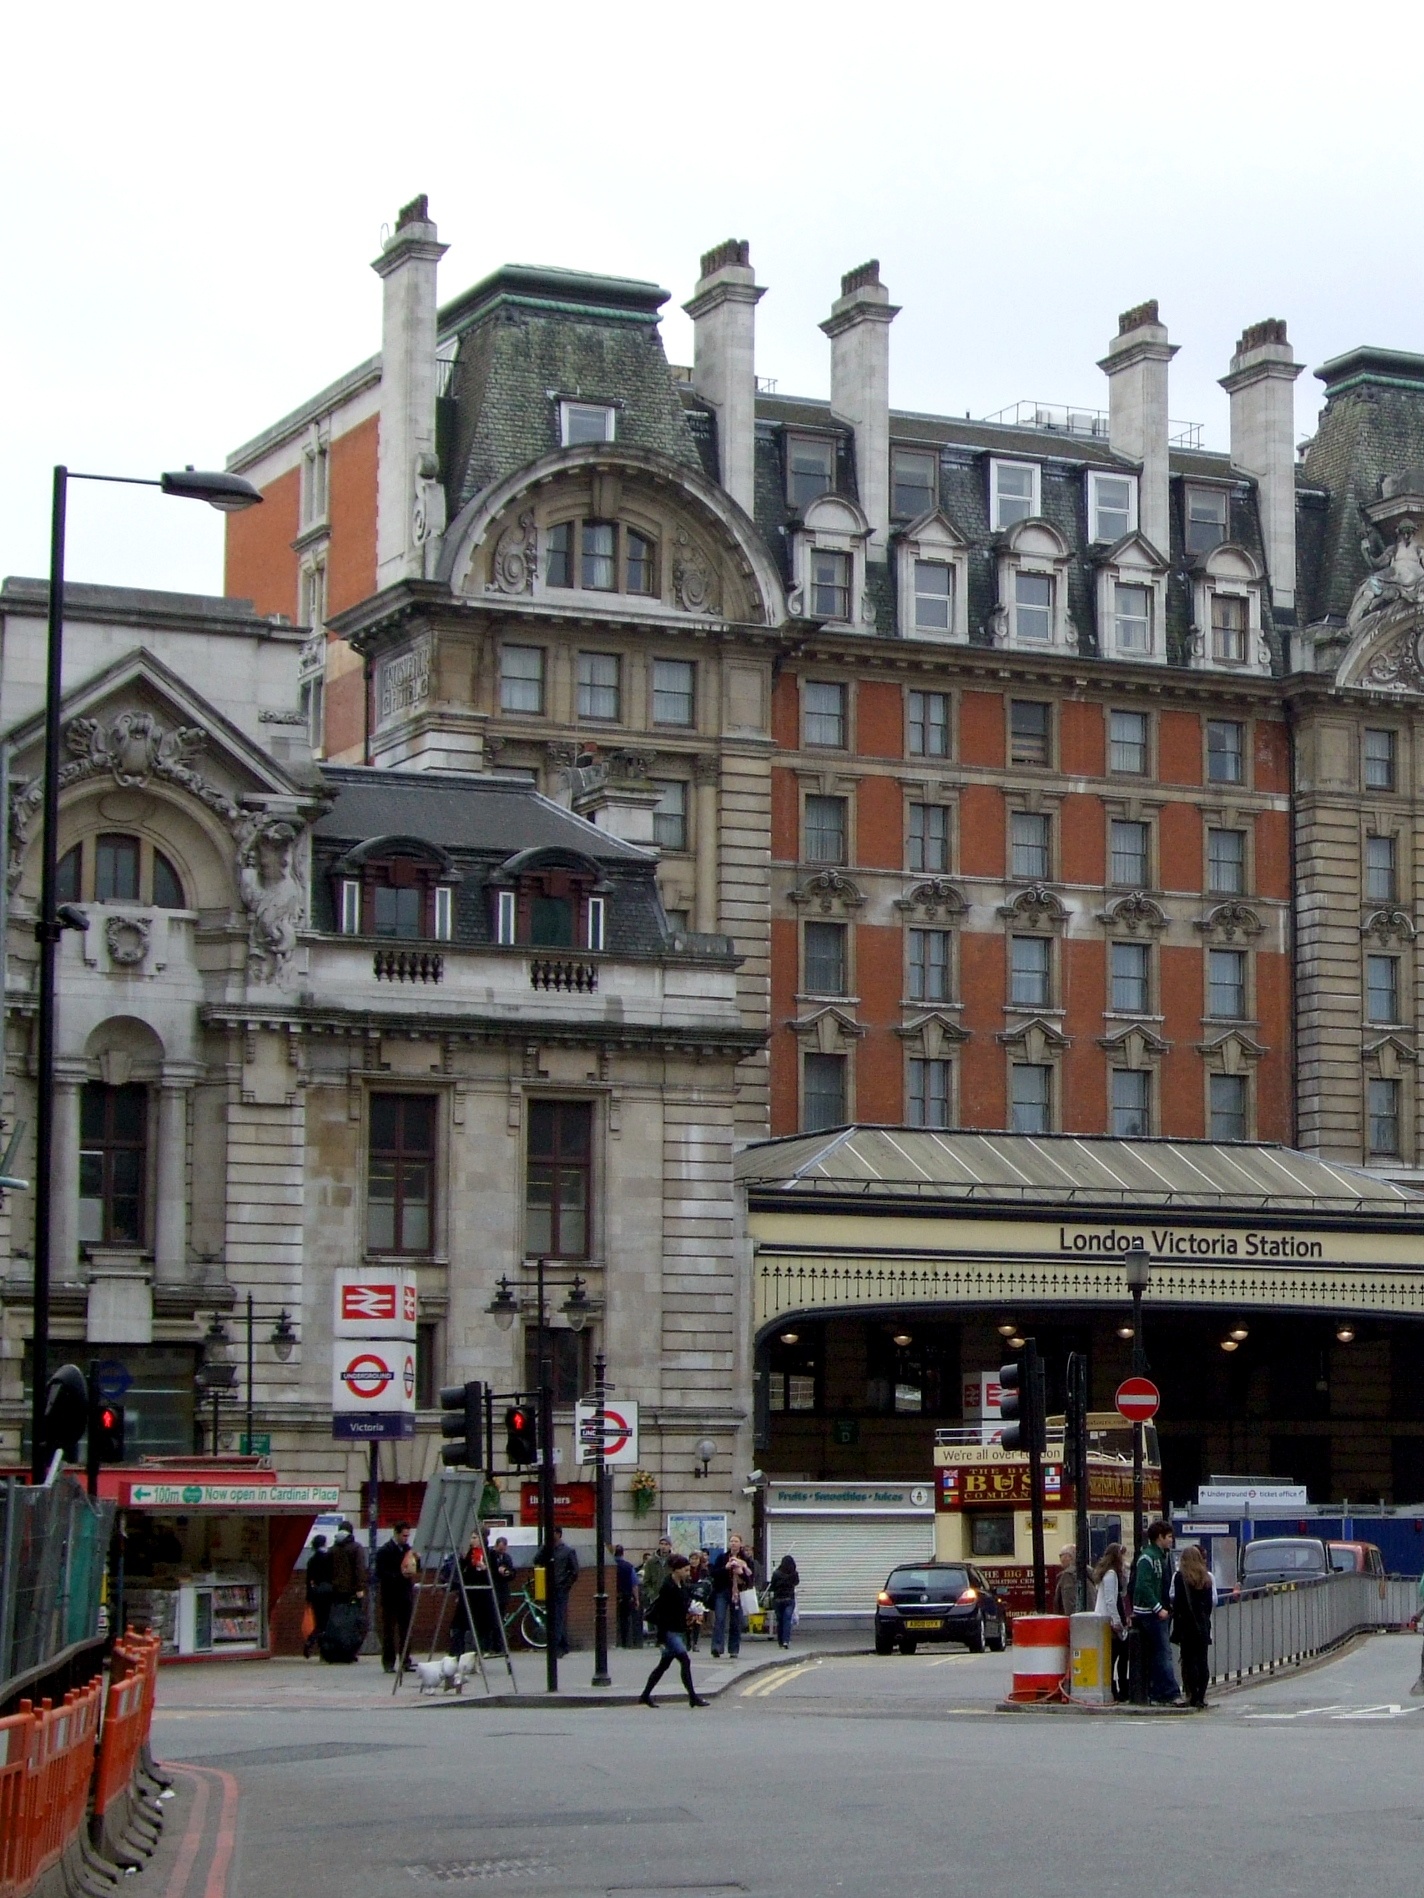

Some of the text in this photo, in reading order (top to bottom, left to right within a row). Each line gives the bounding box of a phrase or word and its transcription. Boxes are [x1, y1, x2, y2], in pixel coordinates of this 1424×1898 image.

[1060, 1227, 1322, 1257] London Victoria Station
[350, 1423, 384, 1431] Victoria
[944, 1448, 1060, 1461] We're all over Lodon
[965, 1475, 1031, 1492] BUS
[154, 1487, 179, 1502] 100m
[205, 1487, 226, 1500] Now
[230, 1488, 255, 1501] open
[258, 1487, 267, 1500] in
[269, 1486, 310, 1501] Cardinal
[313, 1487, 338, 1501] Place
[778, 1491, 808, 1501] Fruits
[874, 1492, 903, 1501] Juices
[964, 1491, 1030, 1499] COMPAN
[1207, 1490, 1297, 1499] Underground ticket office
[1004, 1570, 1022, 1578] BIG
[1027, 1568, 1048, 1578] BS
